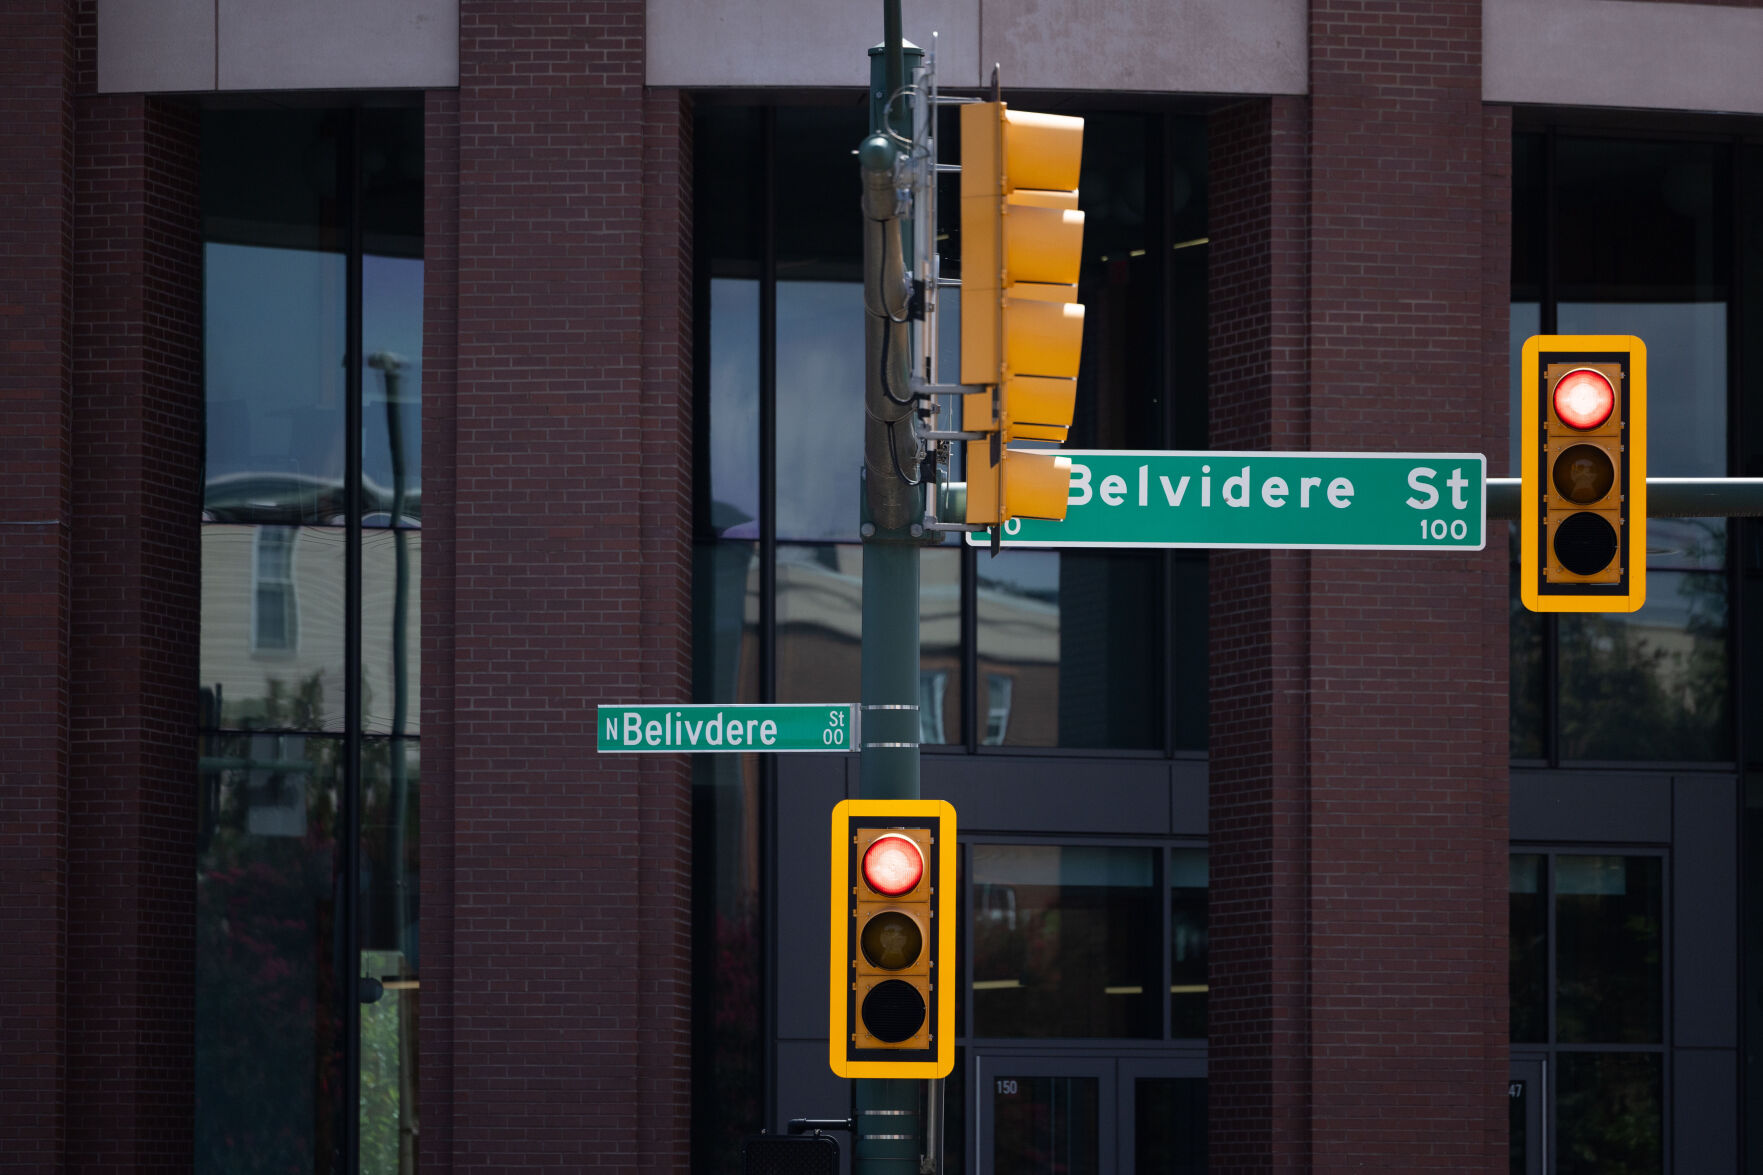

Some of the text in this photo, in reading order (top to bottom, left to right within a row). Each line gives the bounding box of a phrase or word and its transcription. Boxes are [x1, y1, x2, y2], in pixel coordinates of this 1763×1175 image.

[1067, 463, 1469, 510] Belvidere St
[1420, 519, 1468, 540] 100
[606, 710, 845, 746] N Belivdere St
[823, 728, 844, 745] 00
[996, 1080, 1018, 1095] 150
